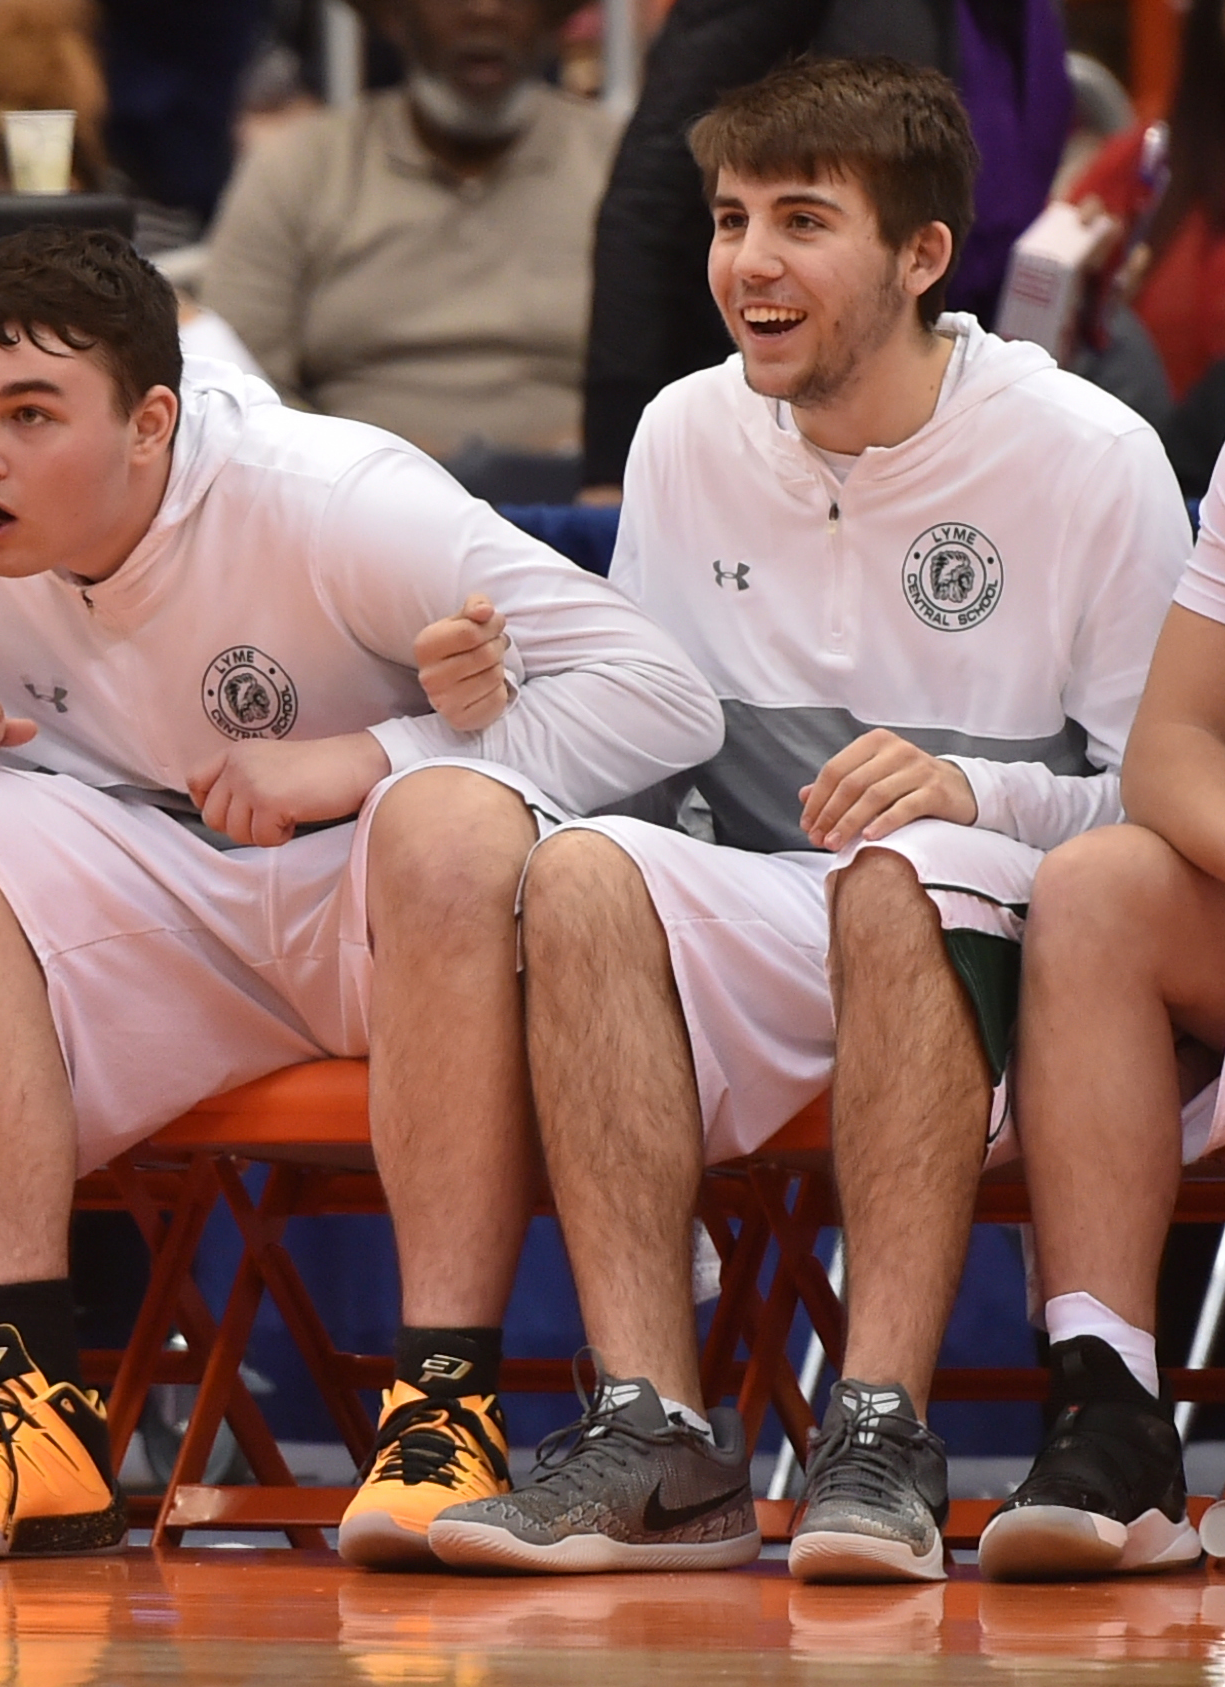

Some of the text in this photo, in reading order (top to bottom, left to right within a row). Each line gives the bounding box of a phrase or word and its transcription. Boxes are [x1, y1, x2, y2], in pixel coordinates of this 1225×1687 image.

[931, 526, 978, 546] LYME
[906, 572, 999, 627] CENTRAL SCHOOL
[214, 649, 255, 675] LYME
[210, 683, 293, 740] CENTRAL SCHOOL
